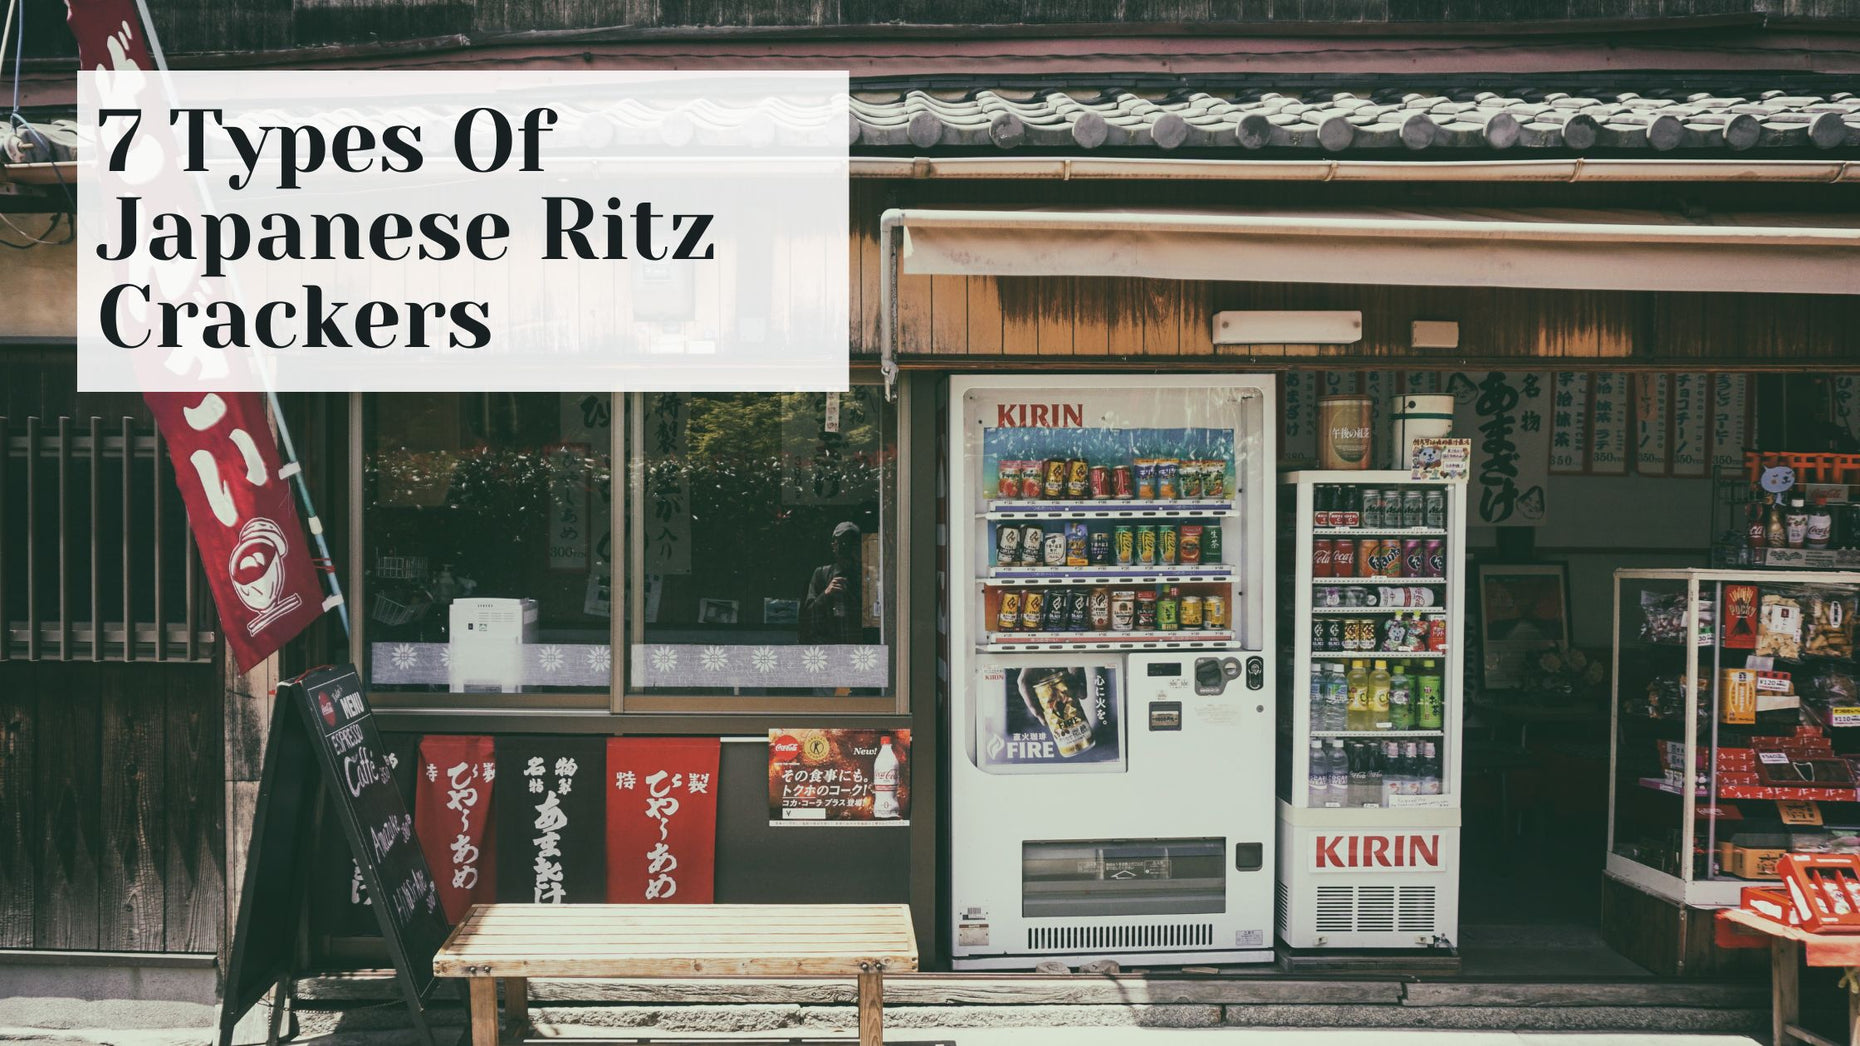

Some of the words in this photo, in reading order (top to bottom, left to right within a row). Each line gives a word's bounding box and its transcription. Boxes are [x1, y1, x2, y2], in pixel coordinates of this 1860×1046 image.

[1520, 373, 1542, 432] 名物
[997, 404, 1083, 428] KIRIN
[1332, 427, 1370, 440] 午後の紅茶
[1476, 371, 1519, 523] あまざけ
[1209, 530, 1219, 549] 生茶
[340, 692, 364, 720] MENU
[1095, 675, 1107, 725] 心に火を。
[331, 723, 363, 756] ESPRESSO
[1013, 733, 1047, 742] 直火珈琲
[853, 747, 878, 756] New!
[1007, 742, 1055, 759] FIRE
[782, 768, 868, 783] その食事にも。
[782, 784, 868, 797] トクホのコーク!
[1316, 835, 1439, 868] KIRIN
